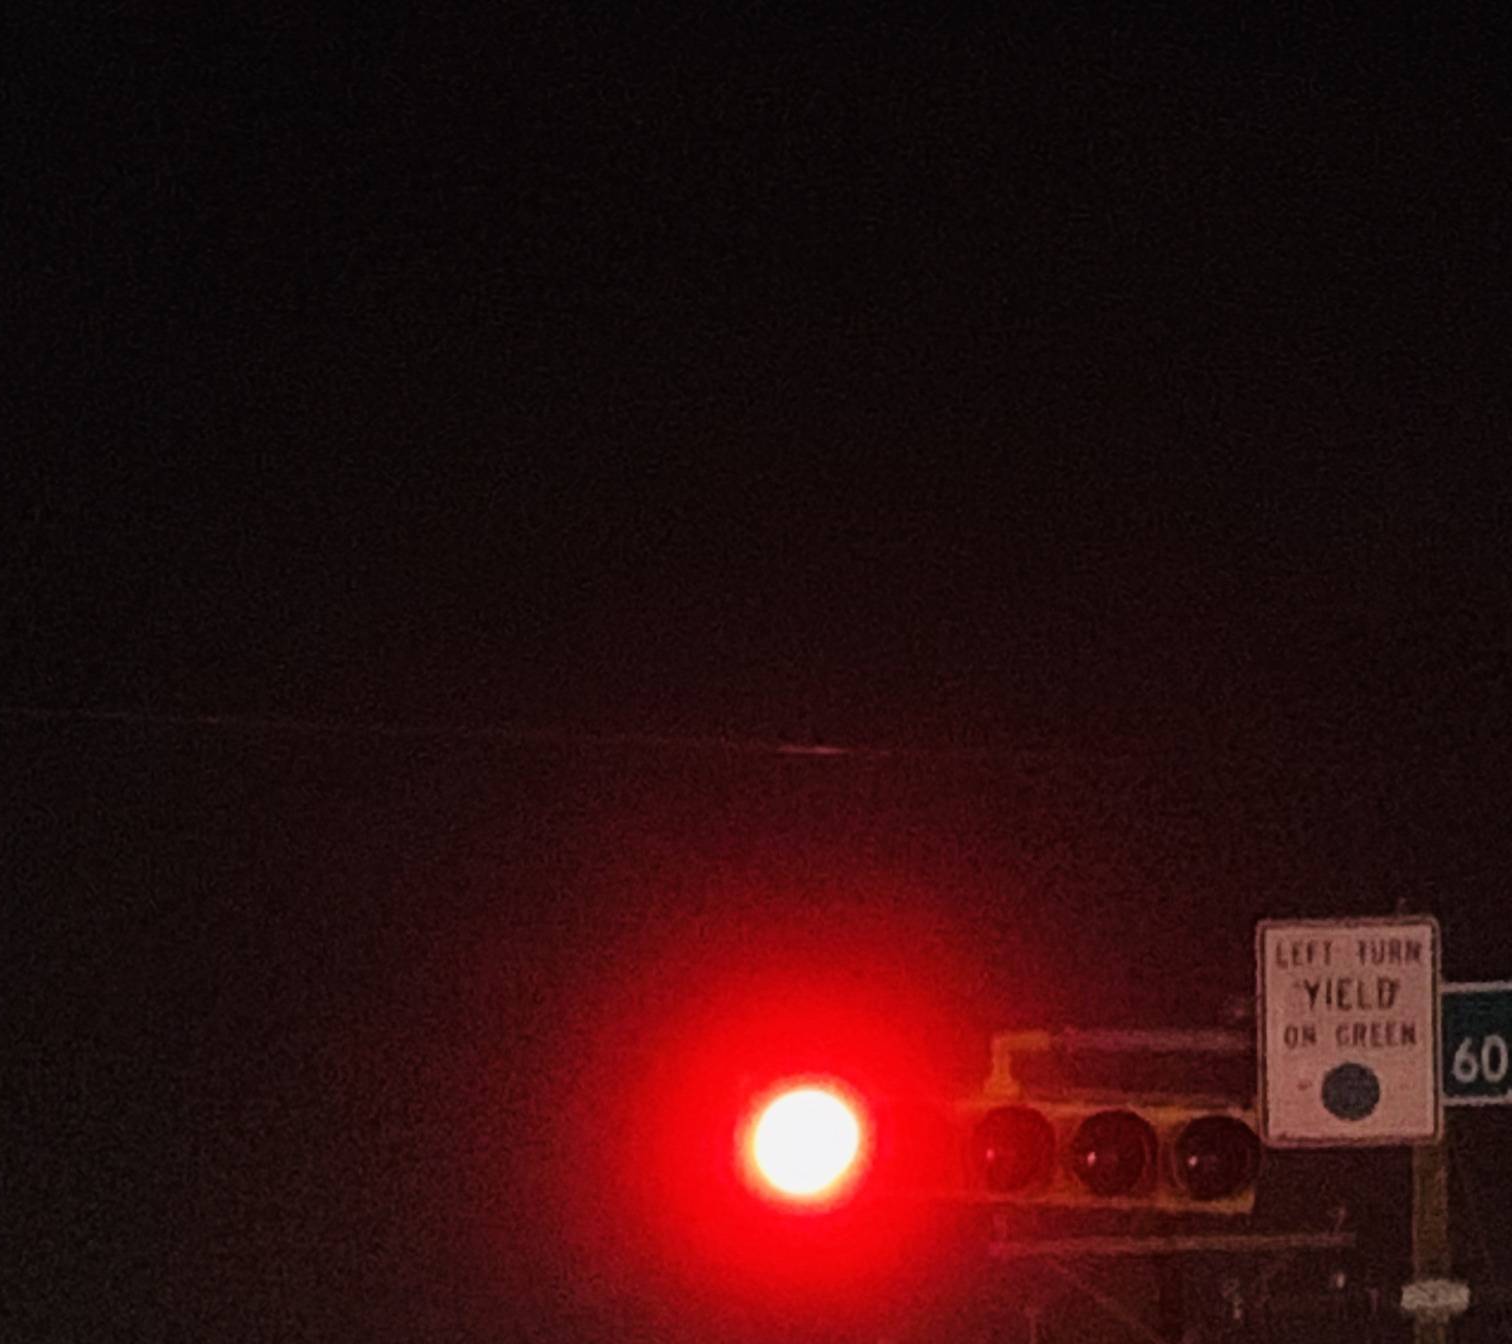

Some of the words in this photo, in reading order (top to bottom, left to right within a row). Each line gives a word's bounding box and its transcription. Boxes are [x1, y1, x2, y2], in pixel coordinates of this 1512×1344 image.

[1275, 939, 1333, 968] LEFT
[1357, 938, 1423, 966] TURN
[1303, 976, 1400, 1011] YIELD
[1284, 1023, 1317, 1049] ON
[1336, 1021, 1416, 1048] GREEN
[1452, 1033, 1508, 1083] 60
